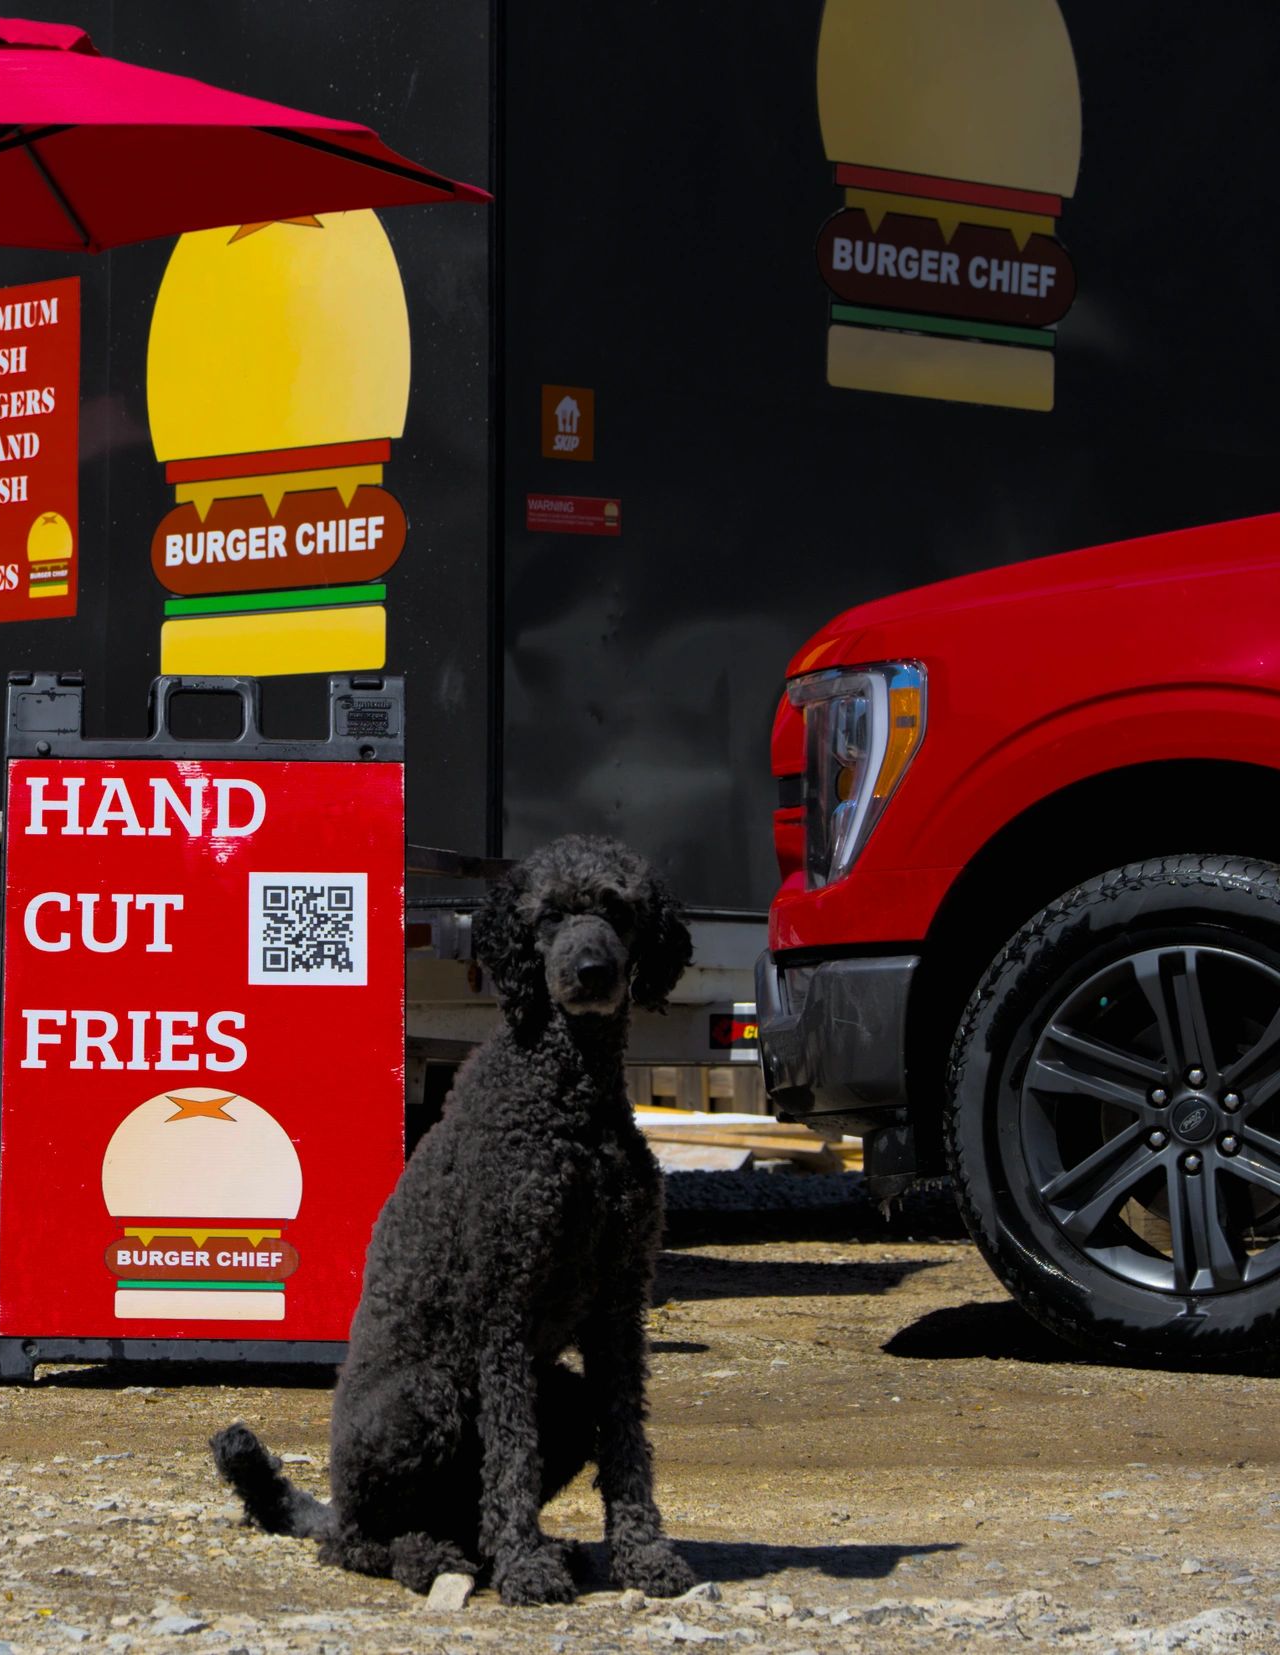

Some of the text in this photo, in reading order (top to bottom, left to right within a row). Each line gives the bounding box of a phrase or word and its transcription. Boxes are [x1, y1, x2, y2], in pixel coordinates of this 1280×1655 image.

[832, 238, 1056, 298] BURGER CHIEF
[553, 434, 580, 452] SKIP
[528, 498, 575, 513] WARNING
[165, 516, 385, 567] BURGER CHIEF
[30, 570, 52, 580] BURGER
[24, 776, 267, 837] HAND
[23, 892, 184, 953] CUT
[20, 1009, 248, 1072] FRIES
[116, 1250, 283, 1268] BURGER CHIEF
